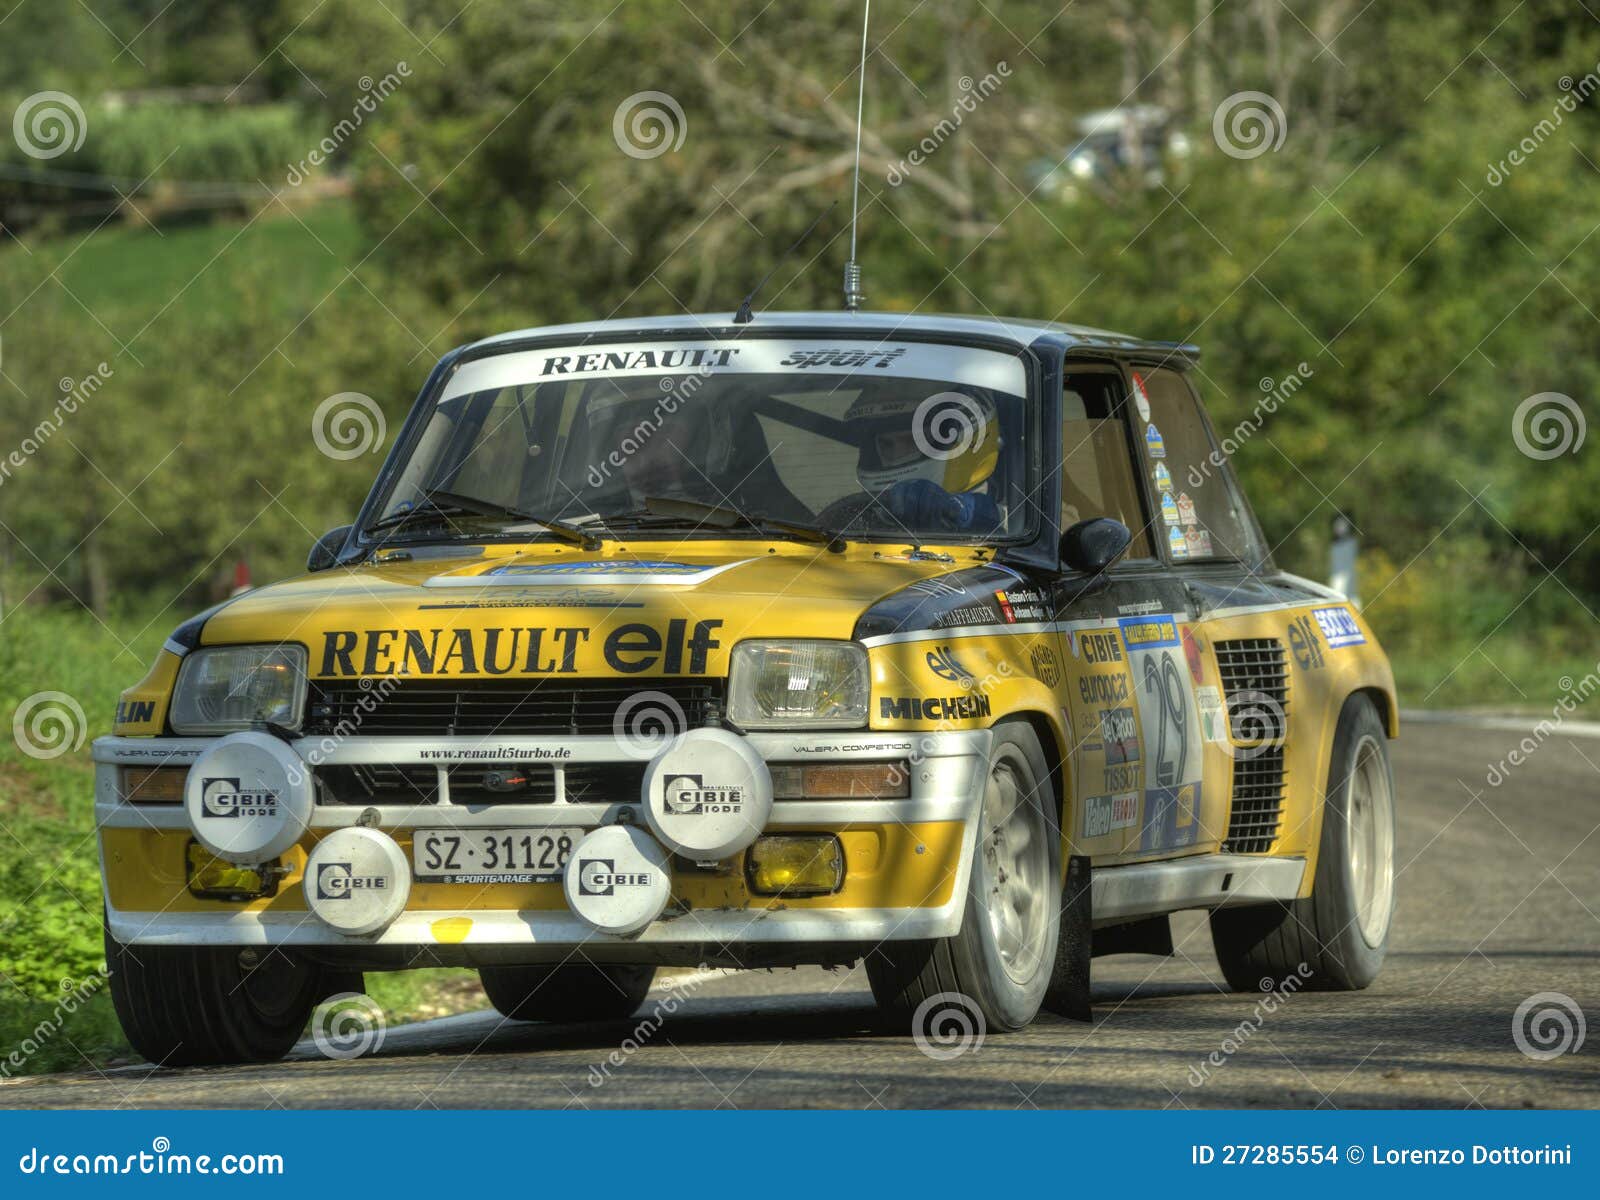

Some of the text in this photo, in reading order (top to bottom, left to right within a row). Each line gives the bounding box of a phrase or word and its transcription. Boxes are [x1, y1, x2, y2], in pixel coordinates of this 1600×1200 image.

[540, 348, 739, 376] RENAULT
[317, 618, 723, 676] RENAULT elf
[926, 646, 976, 681] elf
[880, 694, 991, 719] MICHELIN
[1143, 651, 1188, 787] 29
[420, 747, 571, 759] www.renault5turbo.de
[425, 837, 462, 869] SZ
[455, 874, 533, 884] SPORTGARAGE
